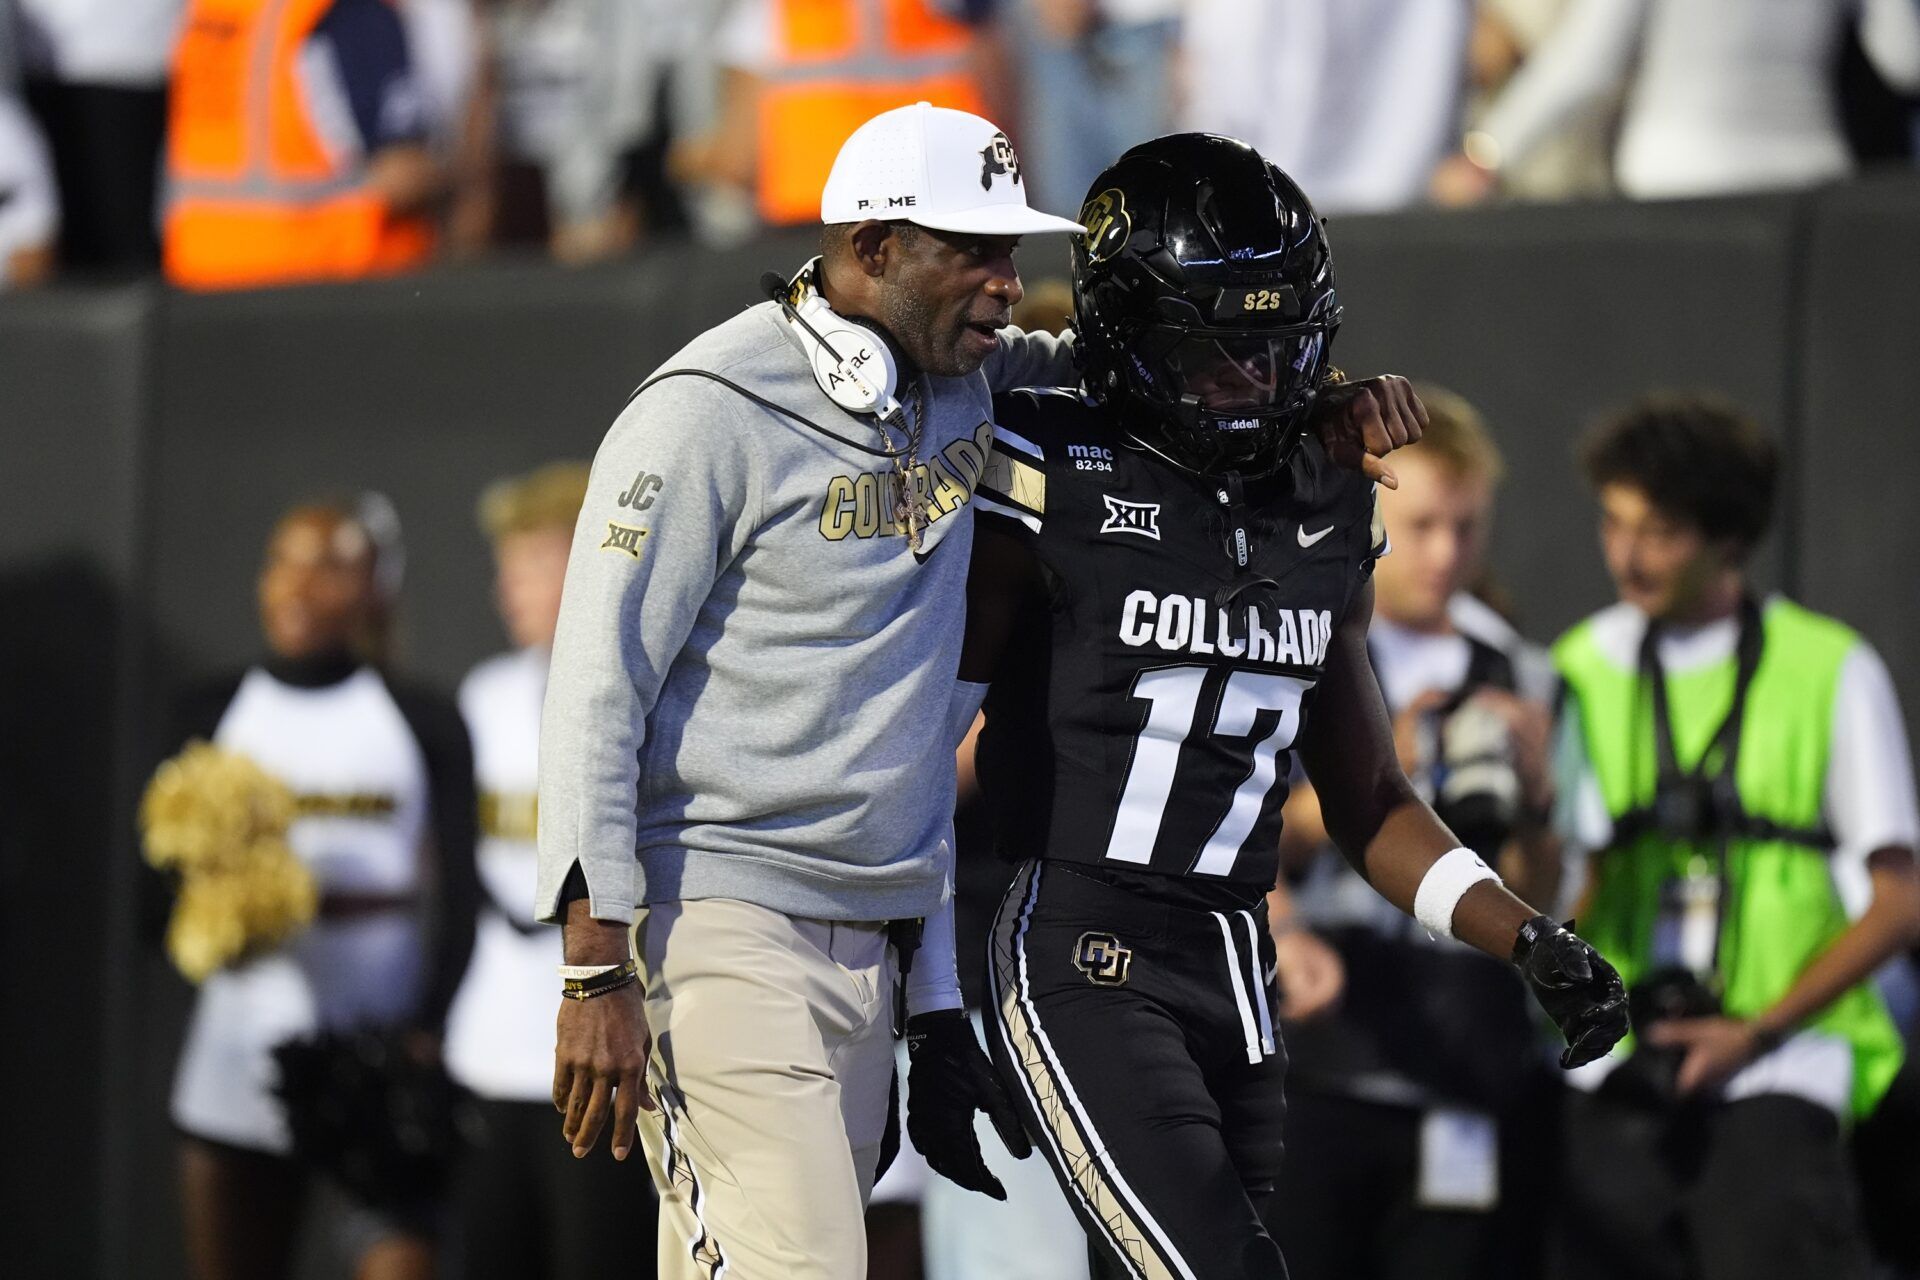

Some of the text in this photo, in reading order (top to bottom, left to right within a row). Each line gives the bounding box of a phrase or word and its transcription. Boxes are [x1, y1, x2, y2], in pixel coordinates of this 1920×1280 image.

[858, 195, 916, 210] PME
[1067, 445, 1113, 460] mac
[1075, 460, 1113, 473] 82-94
[617, 470, 664, 511] JC
[1105, 667, 1317, 877] 17
